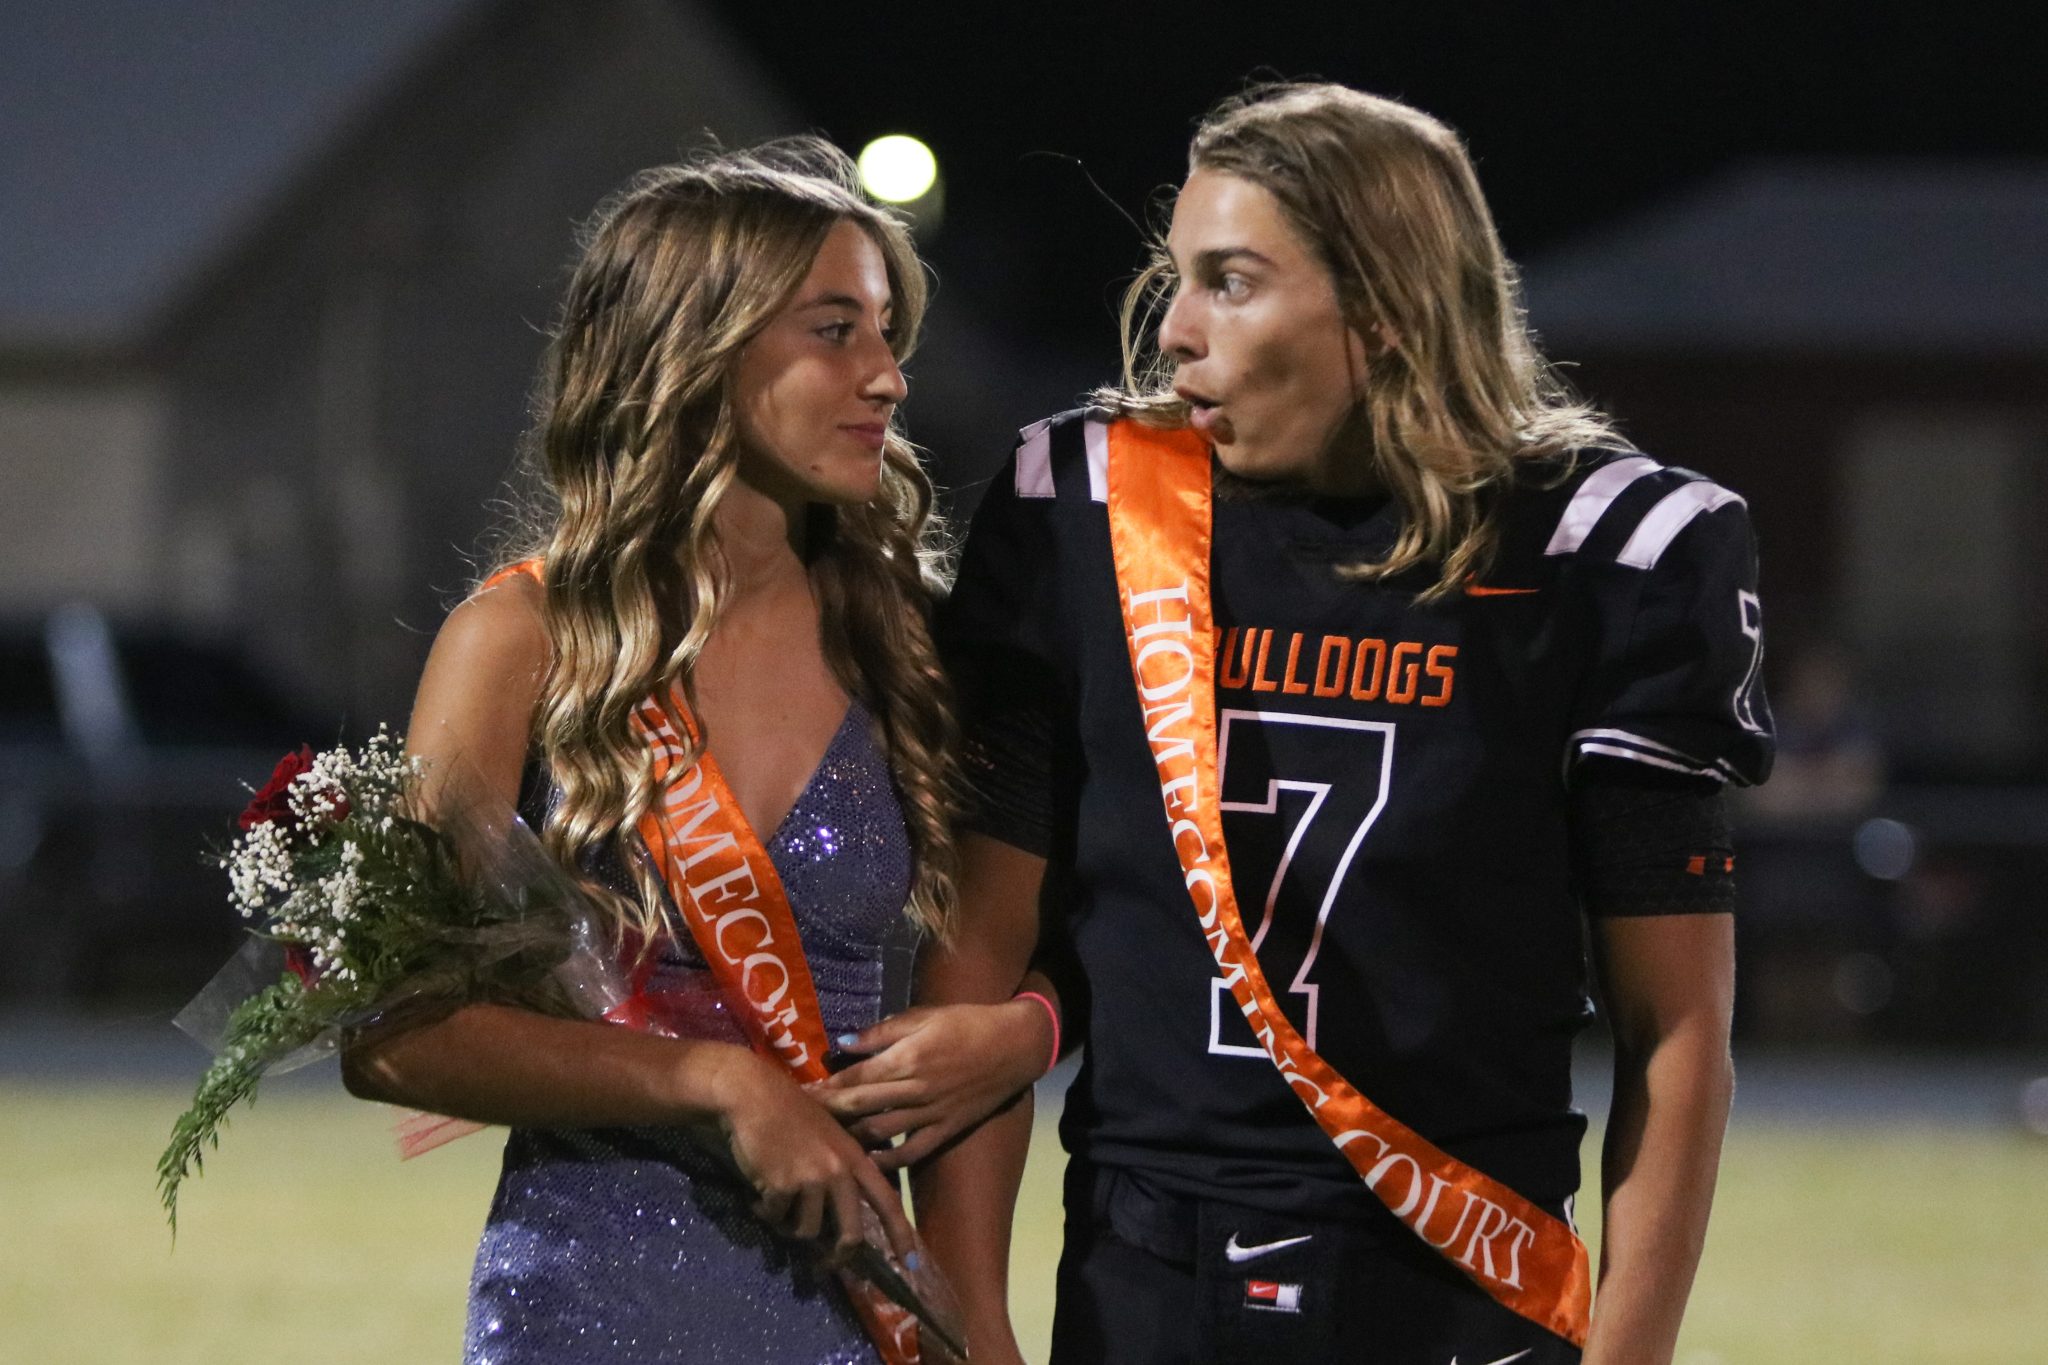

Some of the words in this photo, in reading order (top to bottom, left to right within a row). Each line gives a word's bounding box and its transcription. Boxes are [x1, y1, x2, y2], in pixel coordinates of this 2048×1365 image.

[1213, 626, 1459, 707] ULLDOGS
[1208, 708, 1396, 1058] 7
[1333, 1129, 1536, 1291] COURT
